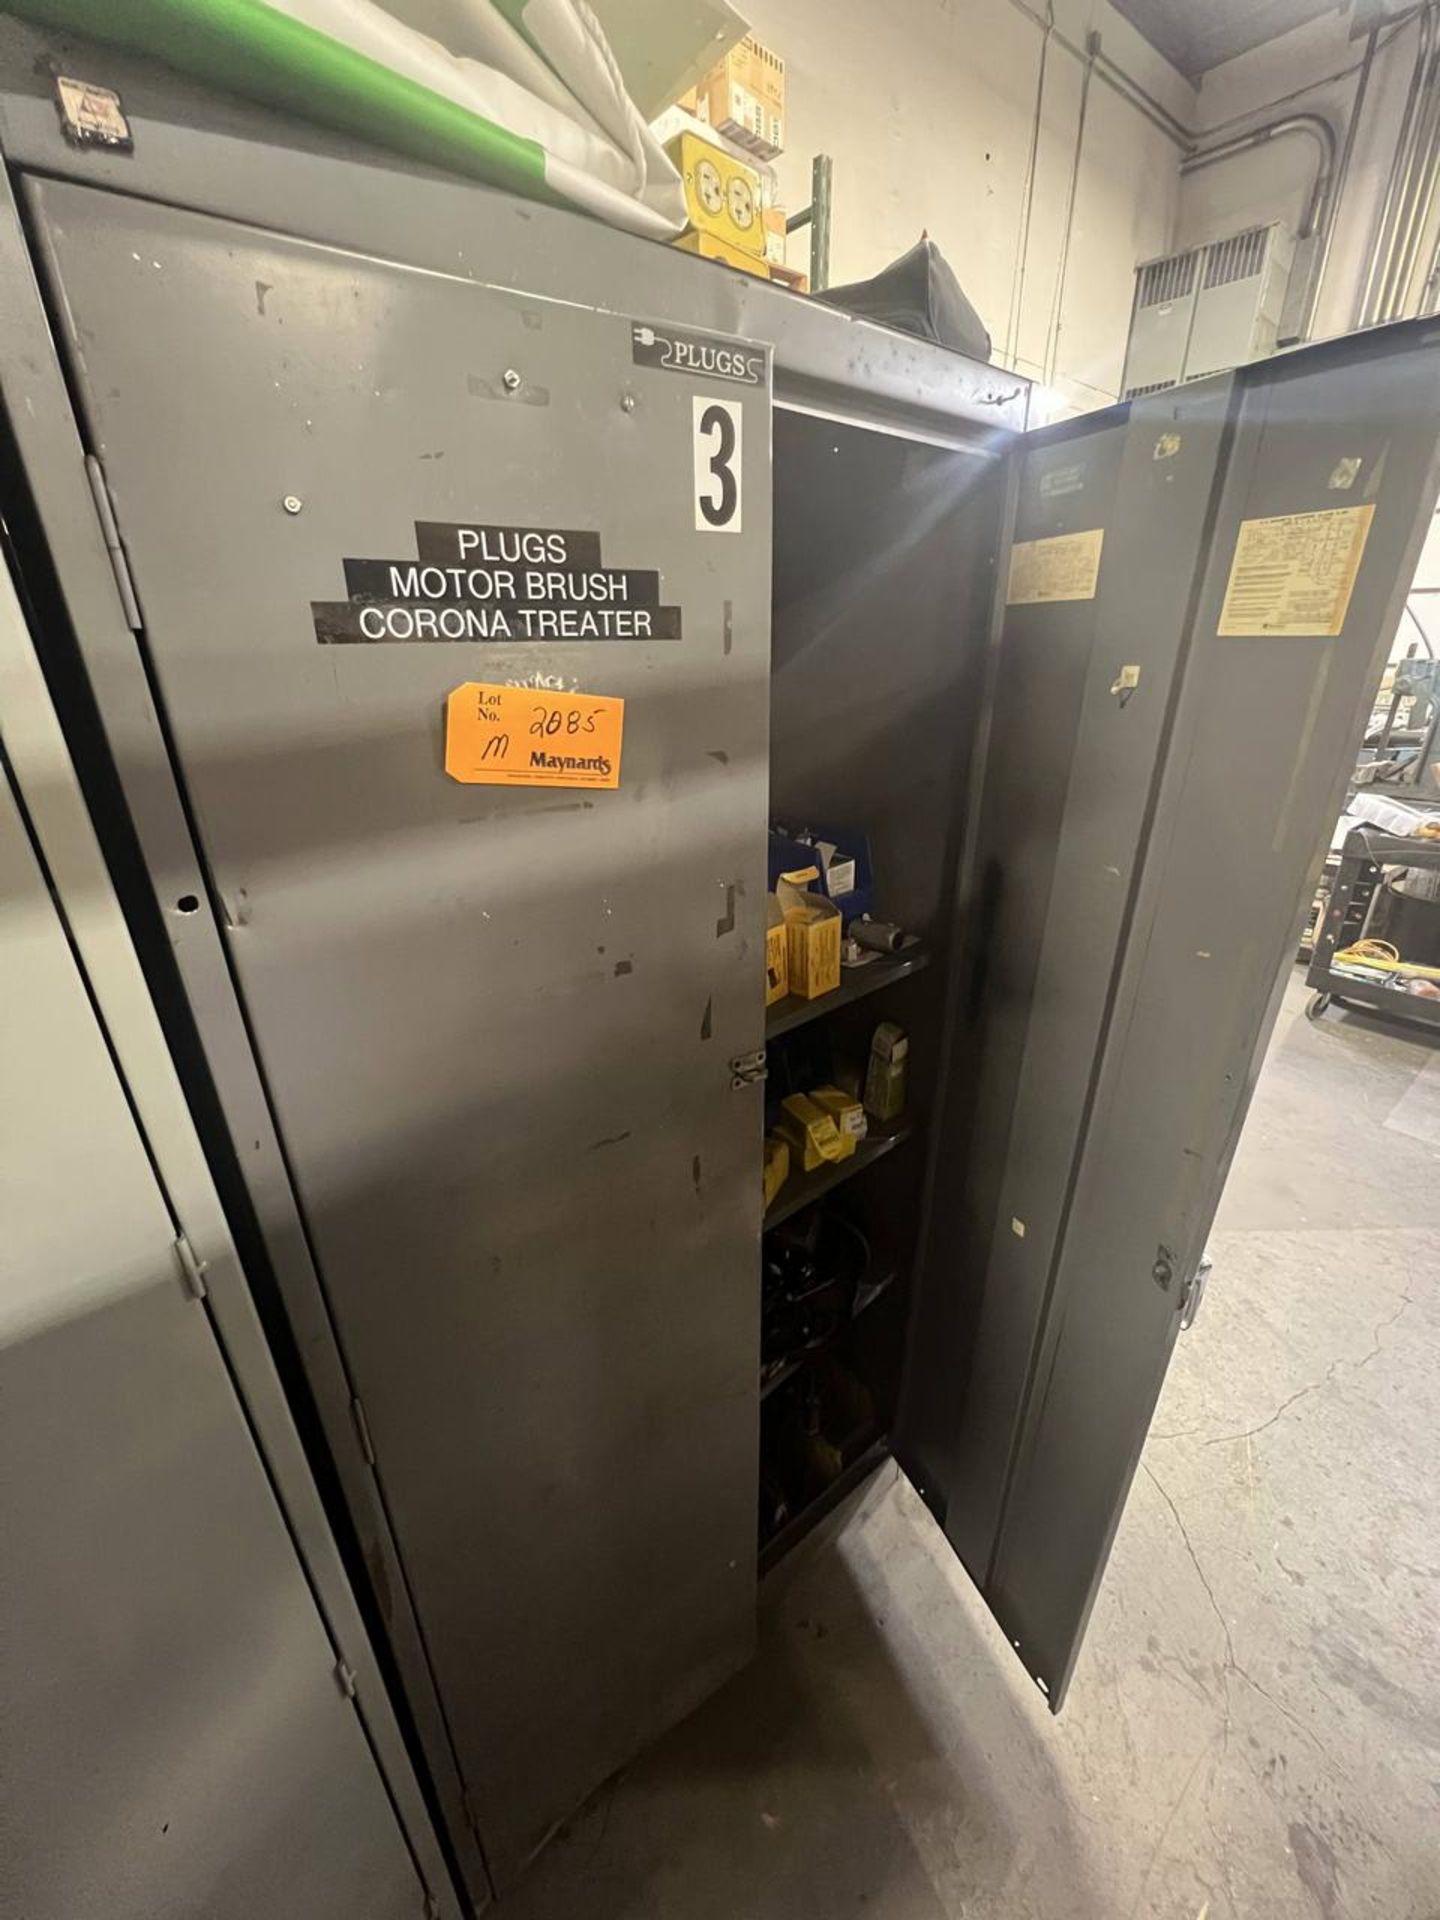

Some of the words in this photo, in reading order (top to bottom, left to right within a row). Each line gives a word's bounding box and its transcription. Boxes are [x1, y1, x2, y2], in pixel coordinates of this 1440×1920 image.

[674, 341, 745, 376] PLUGS
[700, 406, 737, 527] 3
[458, 529, 567, 564] PLUGS
[390, 566, 516, 599] MOTOR
[526, 571, 628, 601] BRUSH
[359, 607, 512, 639] CORONA
[518, 610, 652, 638] TREATER
[477, 707, 500, 721] No.
[478, 691, 501, 706] Lot
[530, 706, 607, 738] 2085
[530, 751, 612, 775] Maynards
